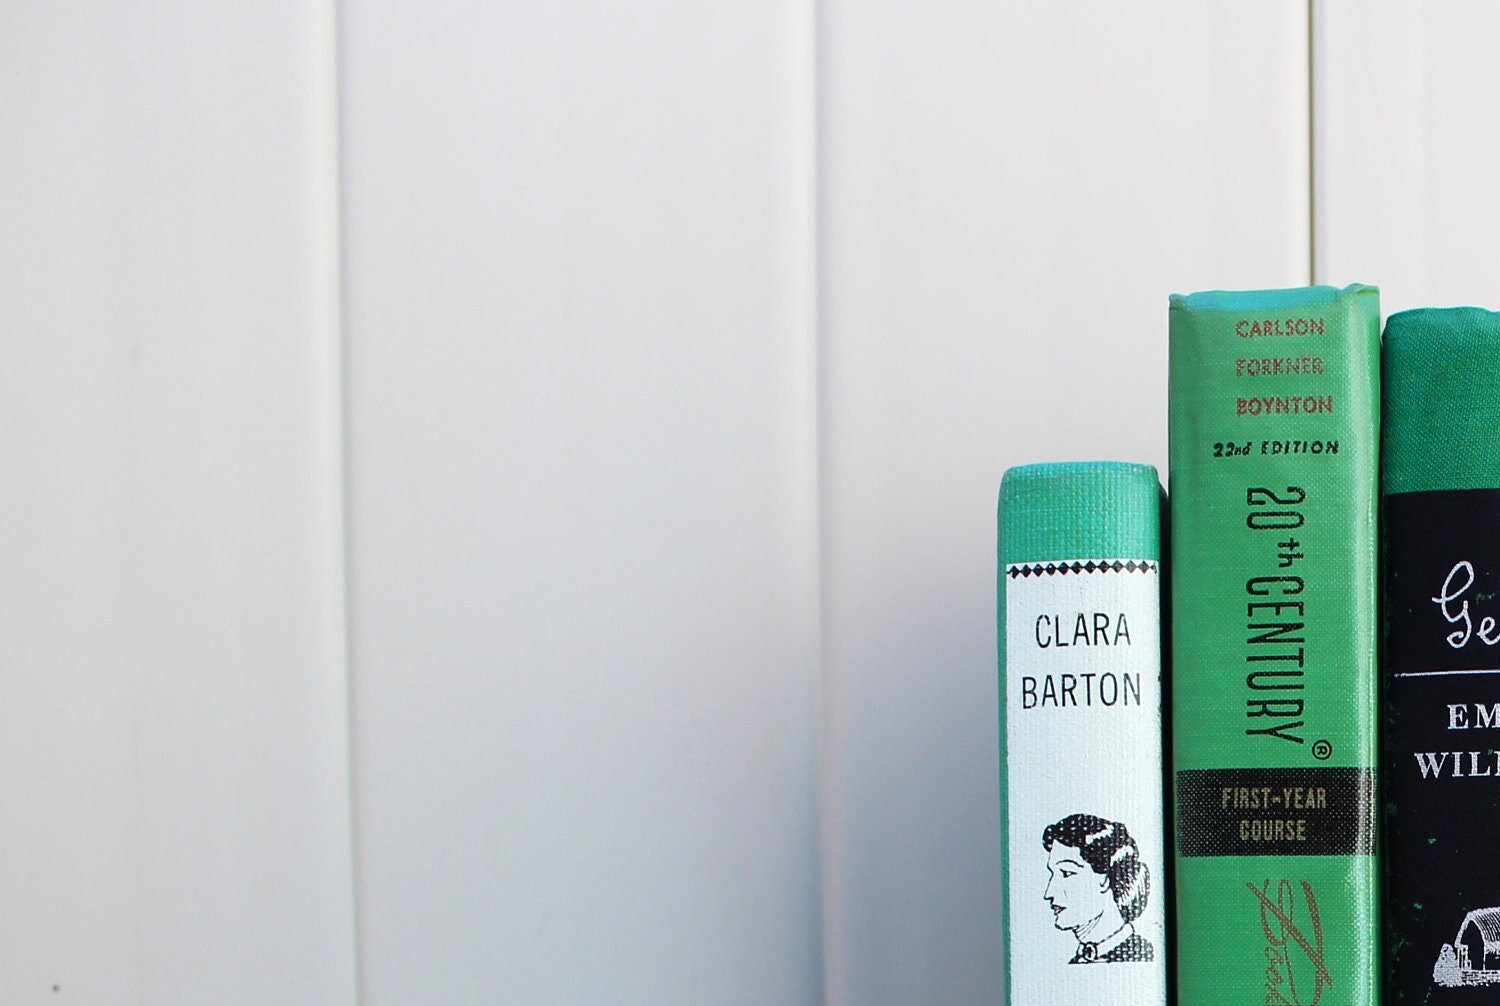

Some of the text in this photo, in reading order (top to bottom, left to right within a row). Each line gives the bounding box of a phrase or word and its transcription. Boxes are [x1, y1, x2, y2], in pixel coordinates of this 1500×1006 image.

[1235, 318, 1325, 338] CARLSON
[1235, 357, 1324, 377] FORKNER
[1236, 396, 1333, 417] BOYNTON
[1213, 440, 1339, 458] 22nd EDITION
[1035, 612, 1131, 648] CLARA
[1245, 576, 1305, 744] CENTURY
[1022, 672, 1141, 709] BARTON
[1221, 787, 1327, 809] FIRST-YEAR
[1240, 819, 1306, 841] COURSE
